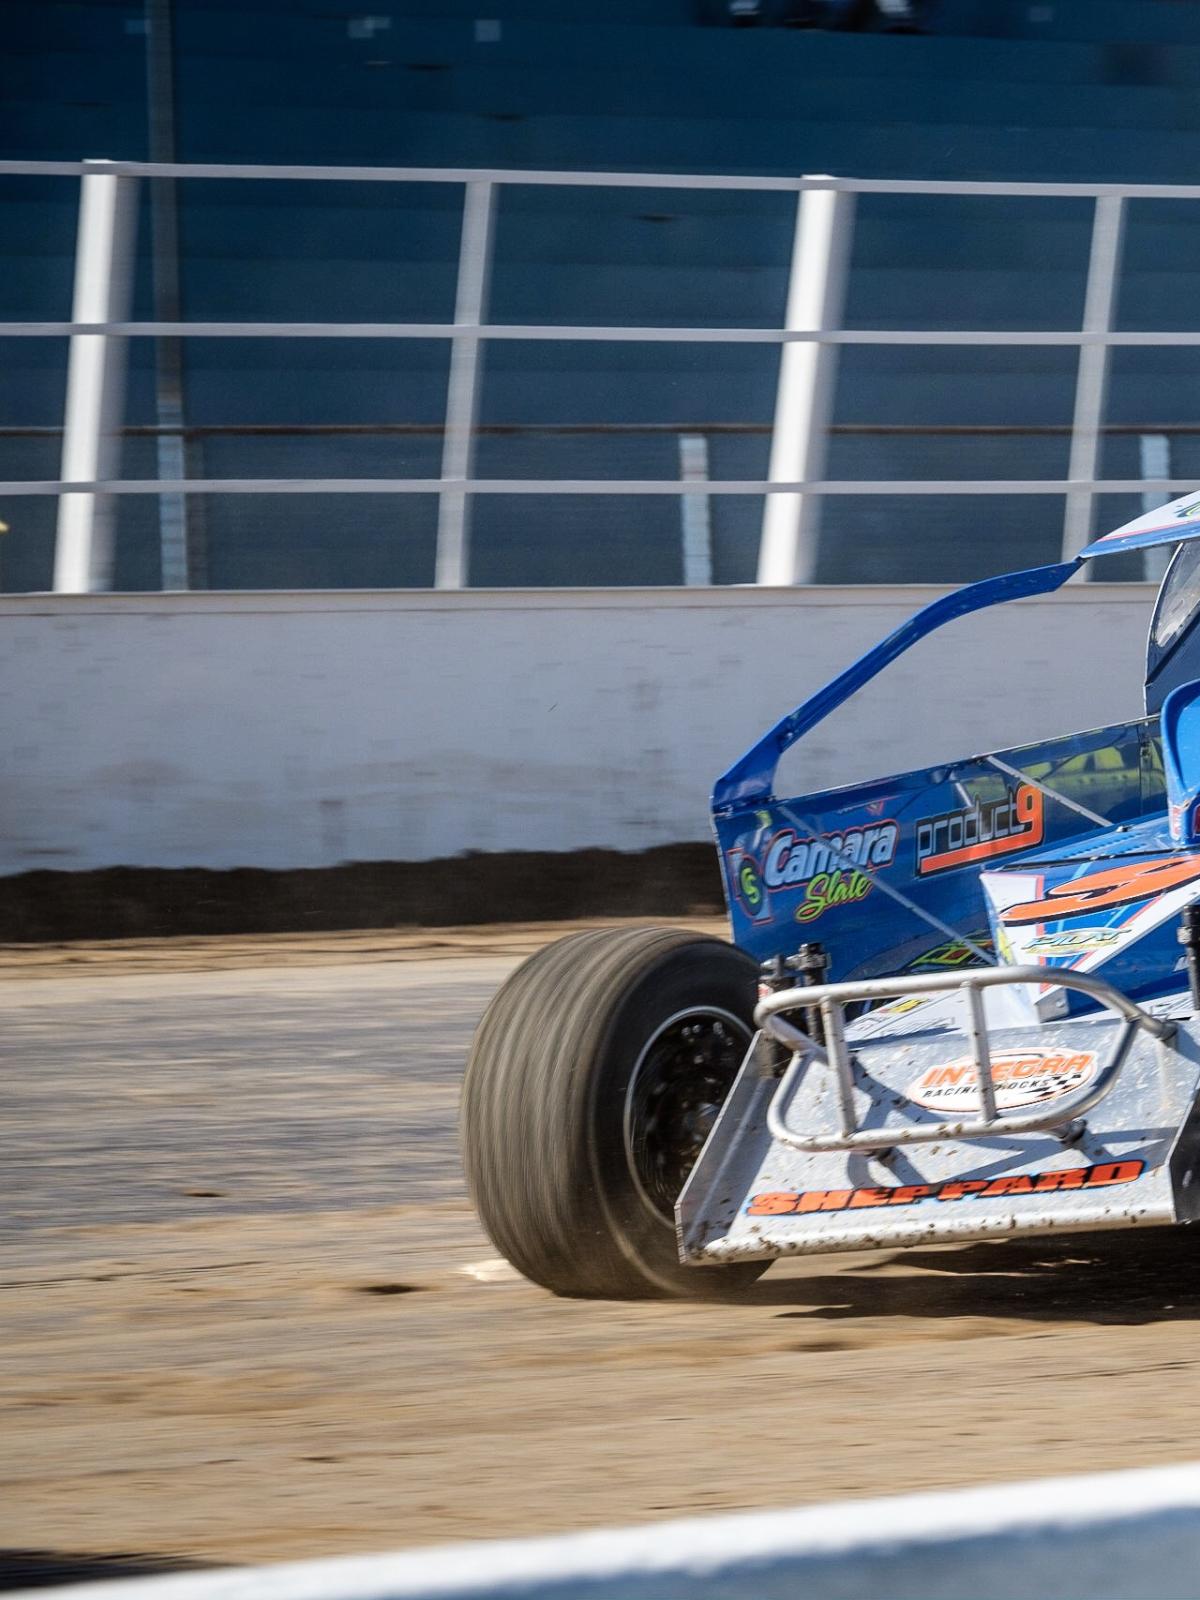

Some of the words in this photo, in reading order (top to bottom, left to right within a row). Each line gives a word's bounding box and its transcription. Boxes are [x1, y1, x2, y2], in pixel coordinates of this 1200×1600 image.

[764, 825, 898, 887] Camara
[796, 868, 872, 921] Slate
[991, 1079, 1049, 1093] HOCKS
[745, 1159, 1145, 1216] SHEPPARD
